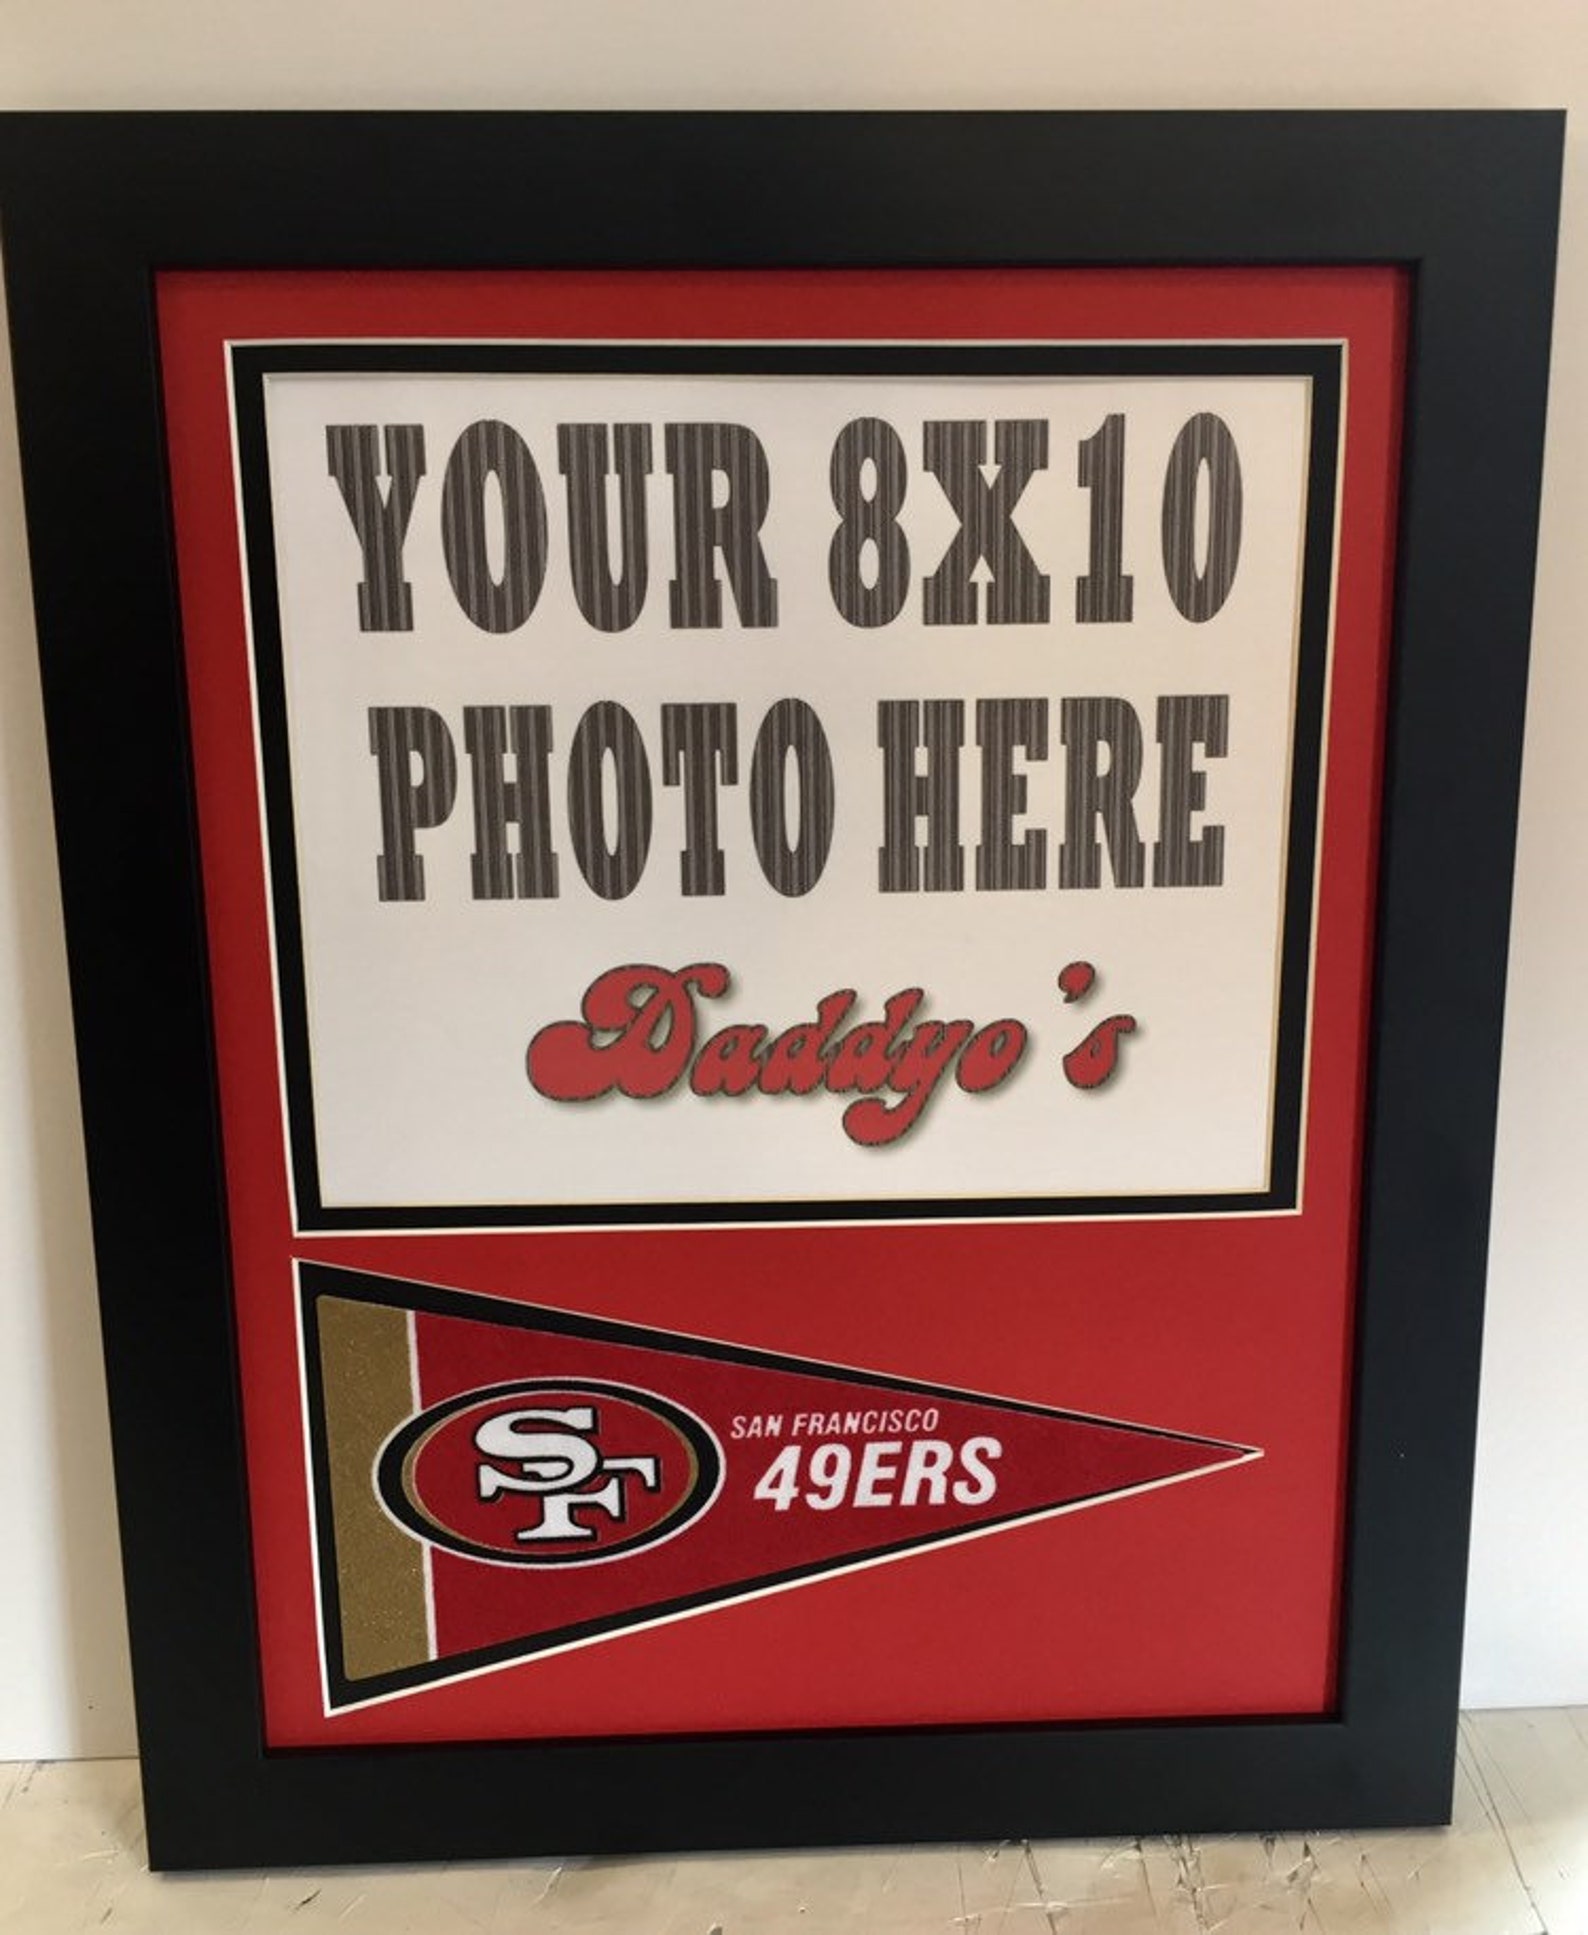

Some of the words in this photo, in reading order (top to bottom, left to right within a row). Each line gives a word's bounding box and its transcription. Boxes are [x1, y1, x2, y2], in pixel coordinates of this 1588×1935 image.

[325, 418, 779, 633] YOUR
[827, 411, 1243, 628] 8X10
[367, 697, 835, 901] PHOTO
[877, 694, 1229, 892] HERE
[525, 960, 1137, 1147] Daddyo's
[730, 1414, 781, 1439] SAN
[791, 1408, 940, 1437] FRANCISCO
[753, 1437, 1002, 1513] 49ERS
